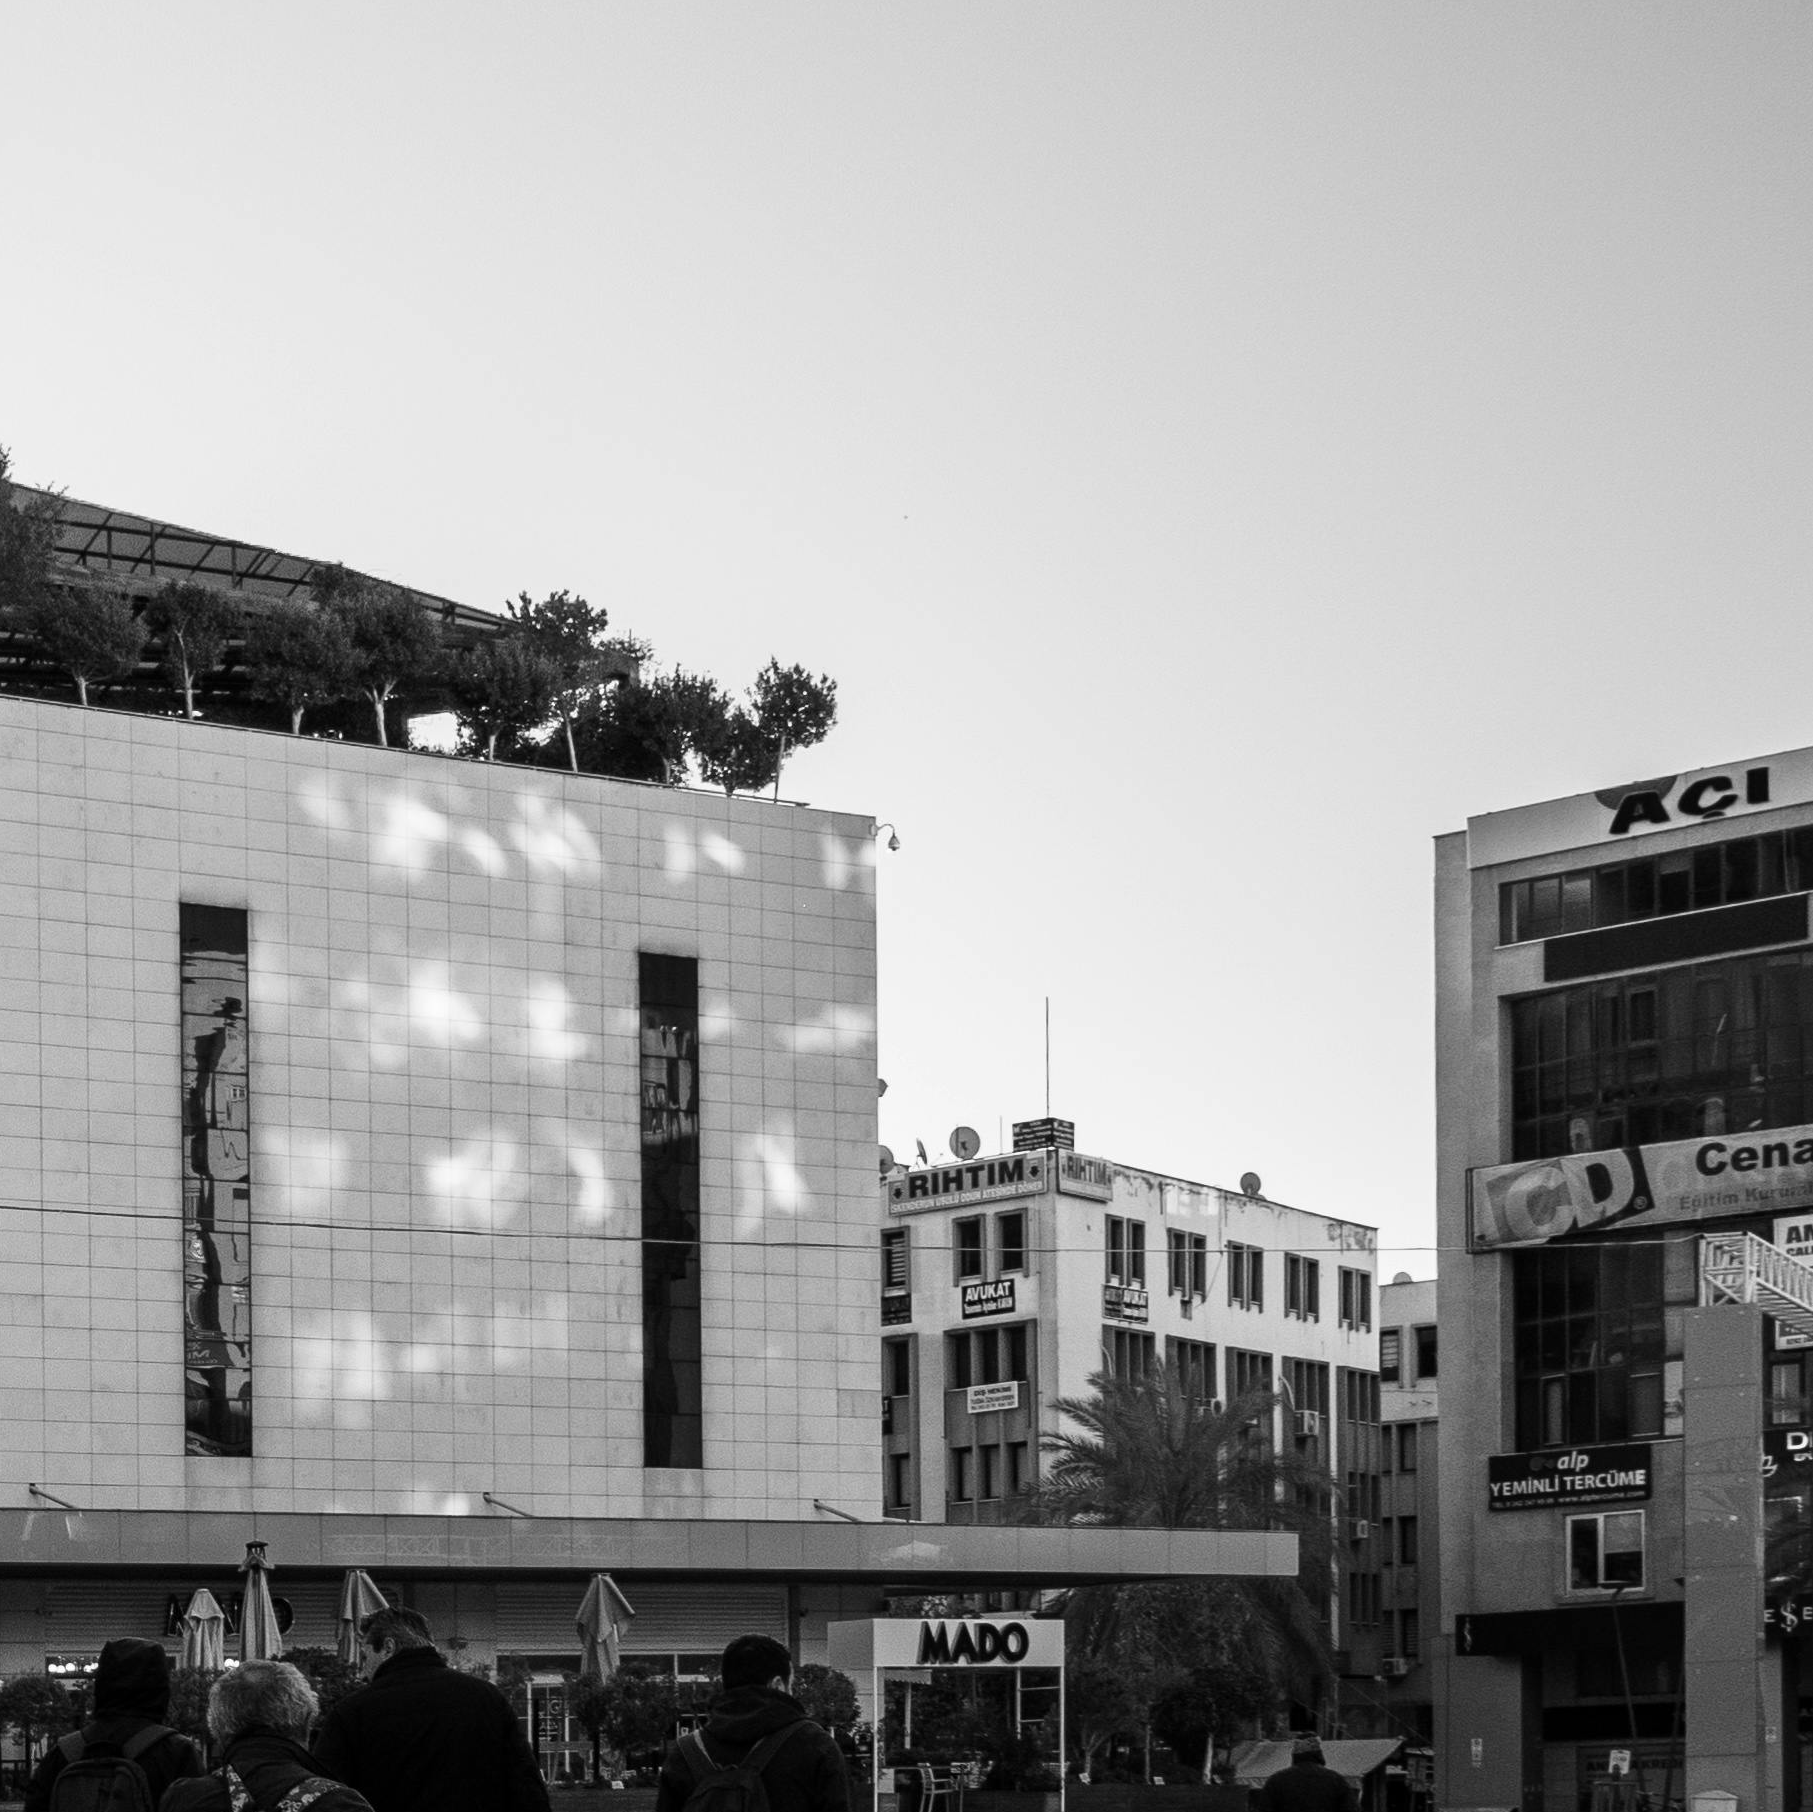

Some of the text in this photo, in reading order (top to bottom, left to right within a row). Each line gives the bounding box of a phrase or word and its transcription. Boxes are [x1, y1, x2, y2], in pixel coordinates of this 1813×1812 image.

[1609, 766, 1770, 834] AÇI
[909, 1159, 1024, 1199] RIHTIM
[965, 1281, 1011, 1302] AVUKAT
[1557, 1451, 1589, 1472] alp
[1490, 1469, 1646, 1497] YEMİNLİ TERCÜME
[916, 1621, 1030, 1665] MADO
